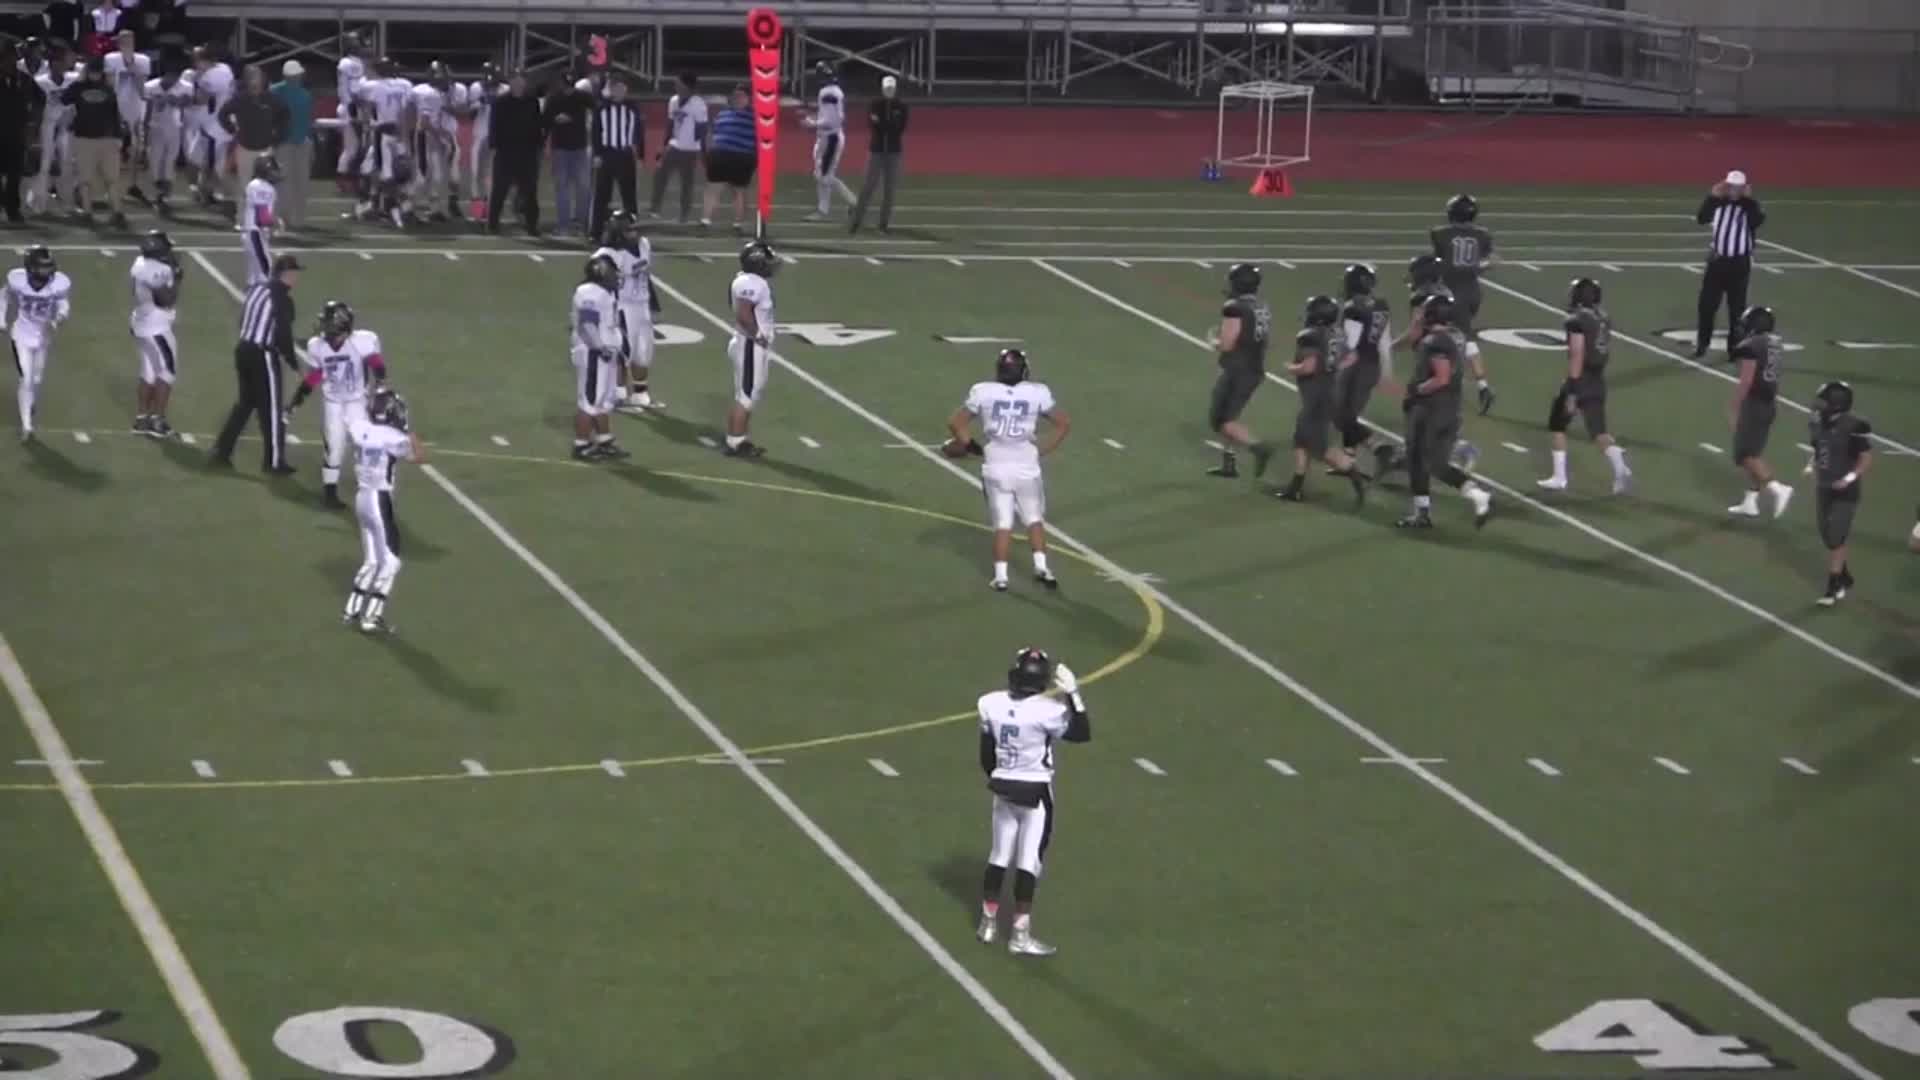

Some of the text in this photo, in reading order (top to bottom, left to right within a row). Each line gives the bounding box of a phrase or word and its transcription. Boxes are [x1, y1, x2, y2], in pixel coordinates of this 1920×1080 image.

[588, 34, 608, 66] 3
[1263, 170, 1284, 193] 30
[1451, 236, 1478, 266] 10
[992, 400, 1029, 438] 52
